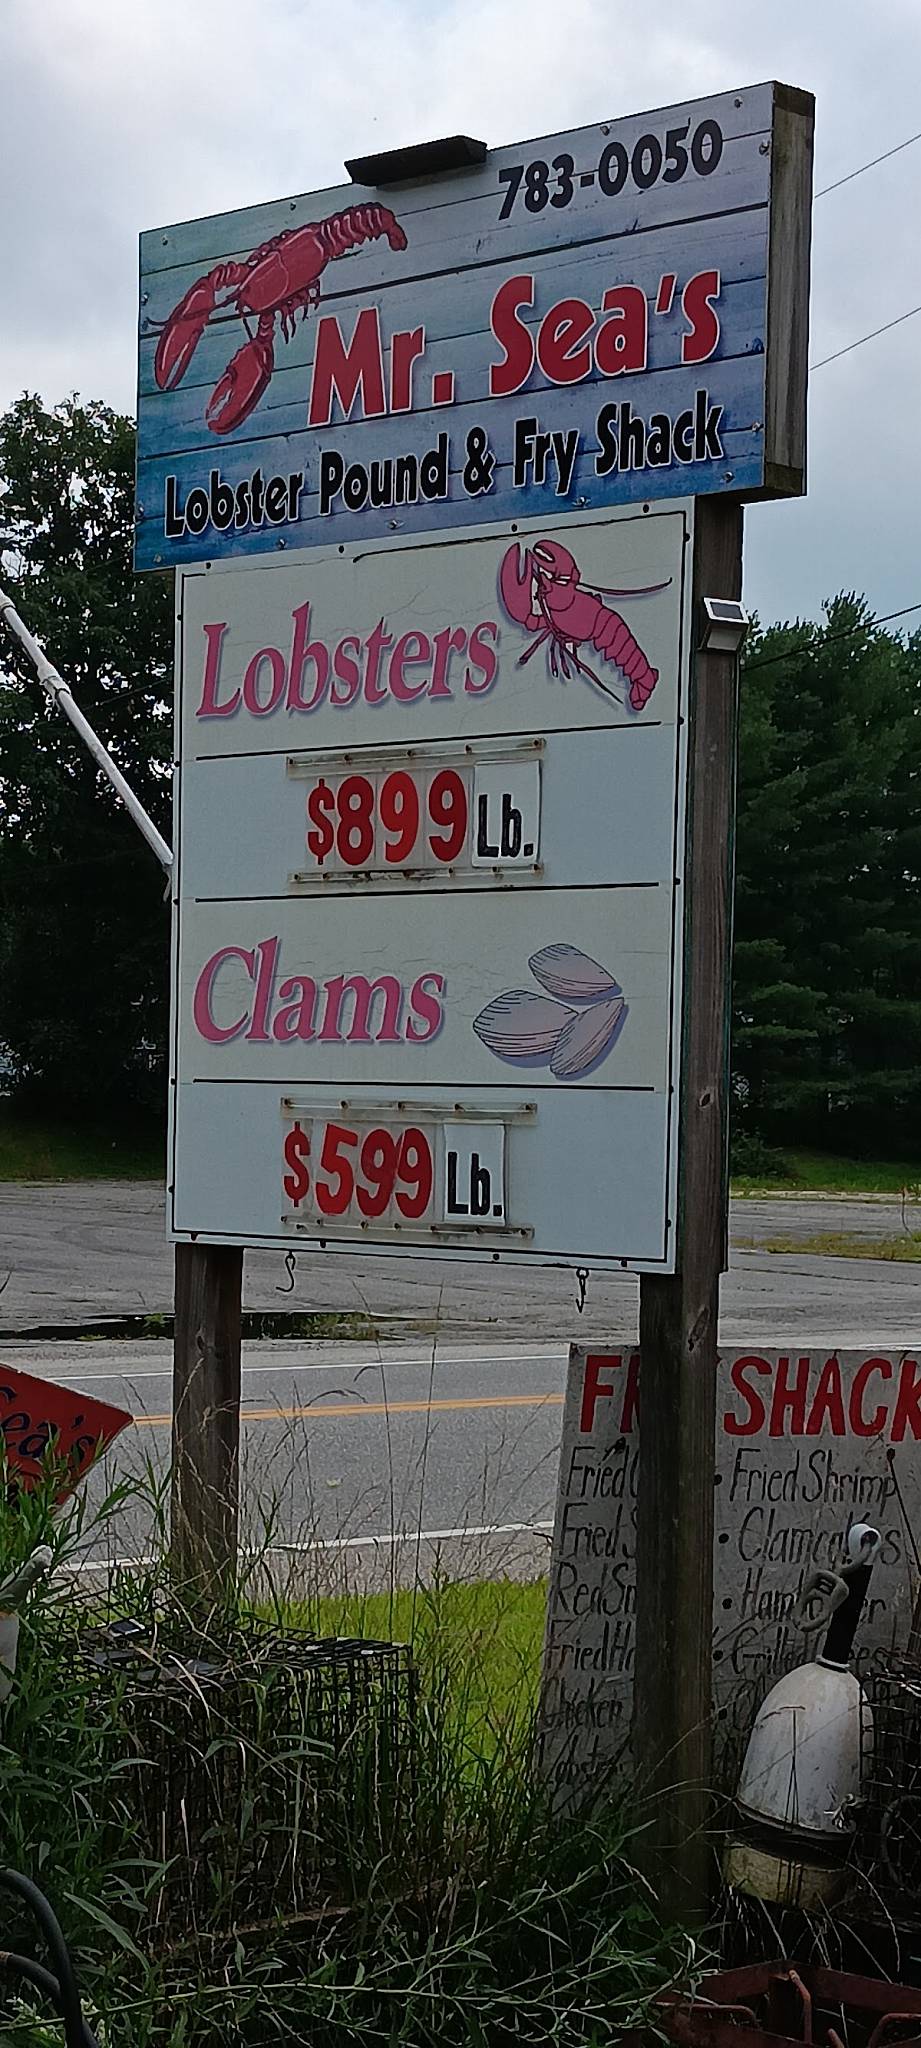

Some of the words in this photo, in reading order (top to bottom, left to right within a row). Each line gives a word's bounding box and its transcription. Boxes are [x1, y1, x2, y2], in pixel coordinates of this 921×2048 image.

[499, 119, 723, 219] 783-0050
[308, 308, 454, 426] Mr.
[490, 270, 721, 398] Sea's
[164, 469, 303, 538] Lobster
[319, 431, 449, 515] Pound
[463, 426, 496, 498] &
[514, 418, 579, 496] Fry
[595, 390, 724, 477] Shack
[196, 601, 500, 718] Lobsters
[307, 769, 468, 866] $899
[476, 793, 534, 860] Lb.
[193, 936, 447, 1045] Clams
[284, 1121, 433, 1219] $599
[446, 1151, 503, 1217] Lb.
[724, 1355, 921, 1442] SHACK
[566, 1445, 629, 1498] Fried
[729, 1447, 800, 1502] Fried
[802, 1449, 897, 1517] Shrimp
[559, 1503, 623, 1558] Fried
[546, 1620, 609, 1671] Fried
